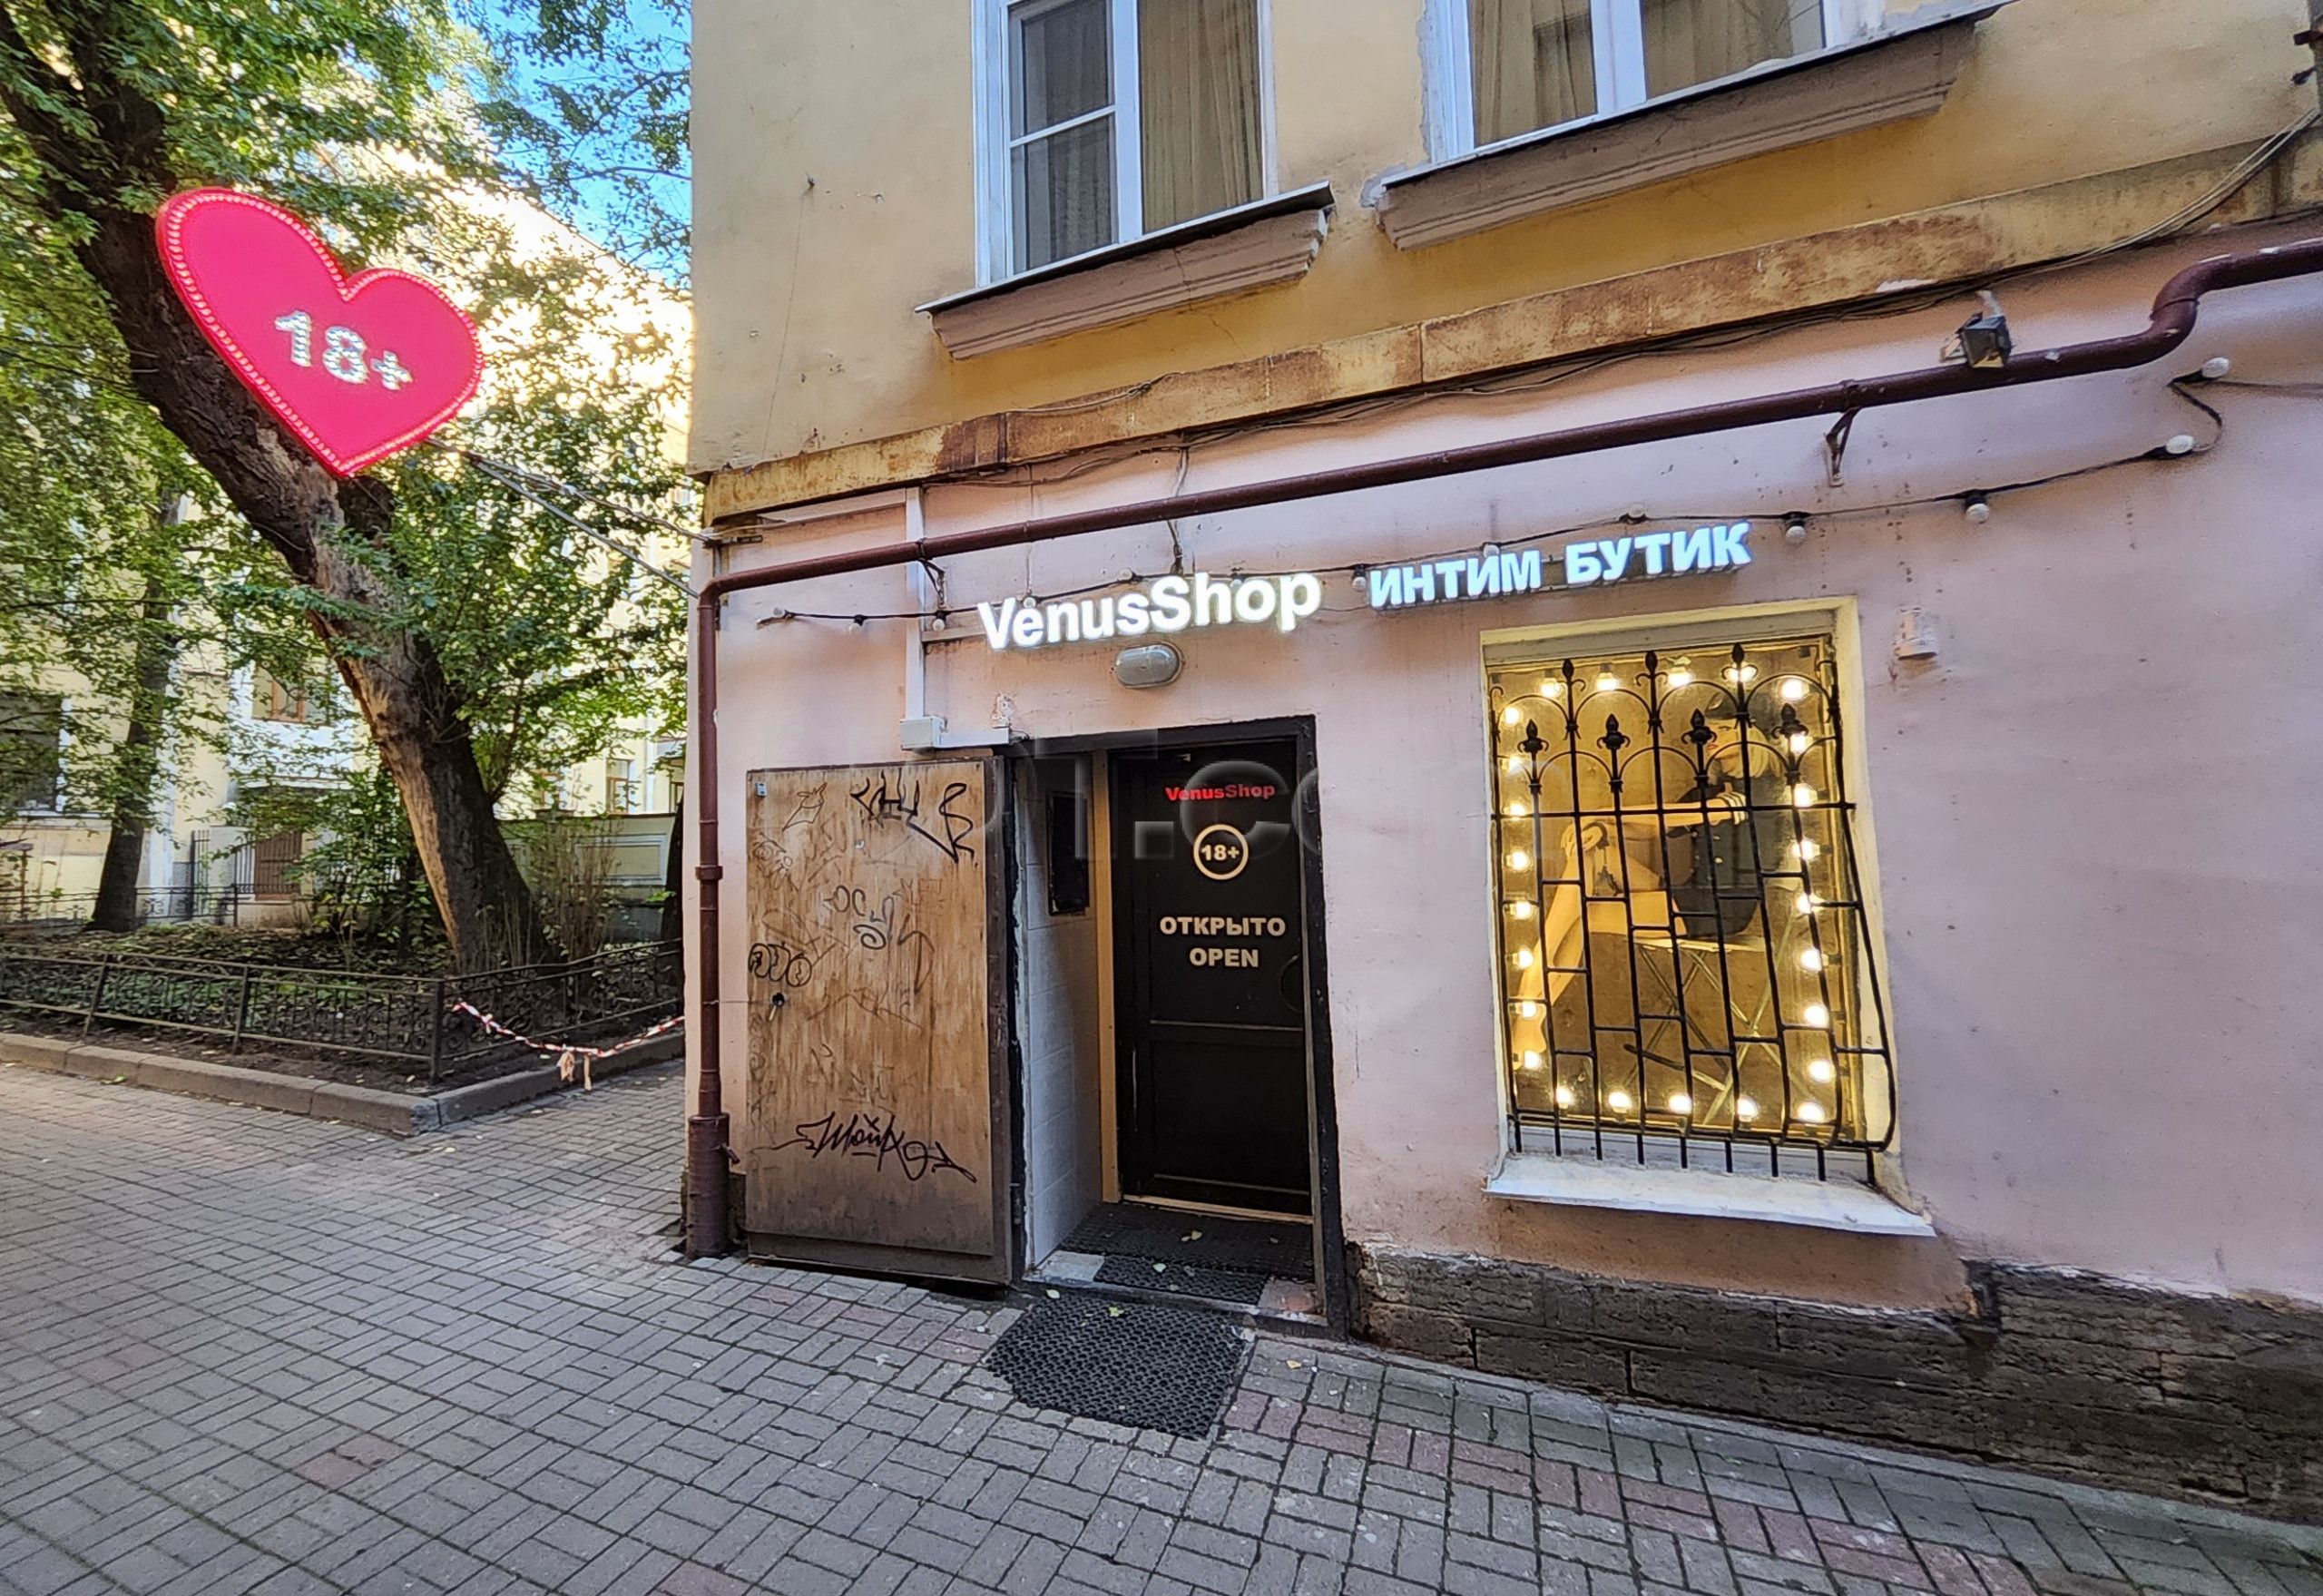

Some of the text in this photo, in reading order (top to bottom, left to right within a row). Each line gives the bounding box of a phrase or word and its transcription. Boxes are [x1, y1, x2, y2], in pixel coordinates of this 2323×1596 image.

[274, 309, 413, 391] 18+
[1368, 522, 1752, 611] ИНТИМ БУТИК
[975, 572, 1323, 651] VenusShop
[1164, 782, 1276, 802] VenusShop
[1200, 844, 1240, 862] 18+
[1159, 915, 1287, 938] ОТКРЫТО
[1189, 946, 1260, 968] OPEN
